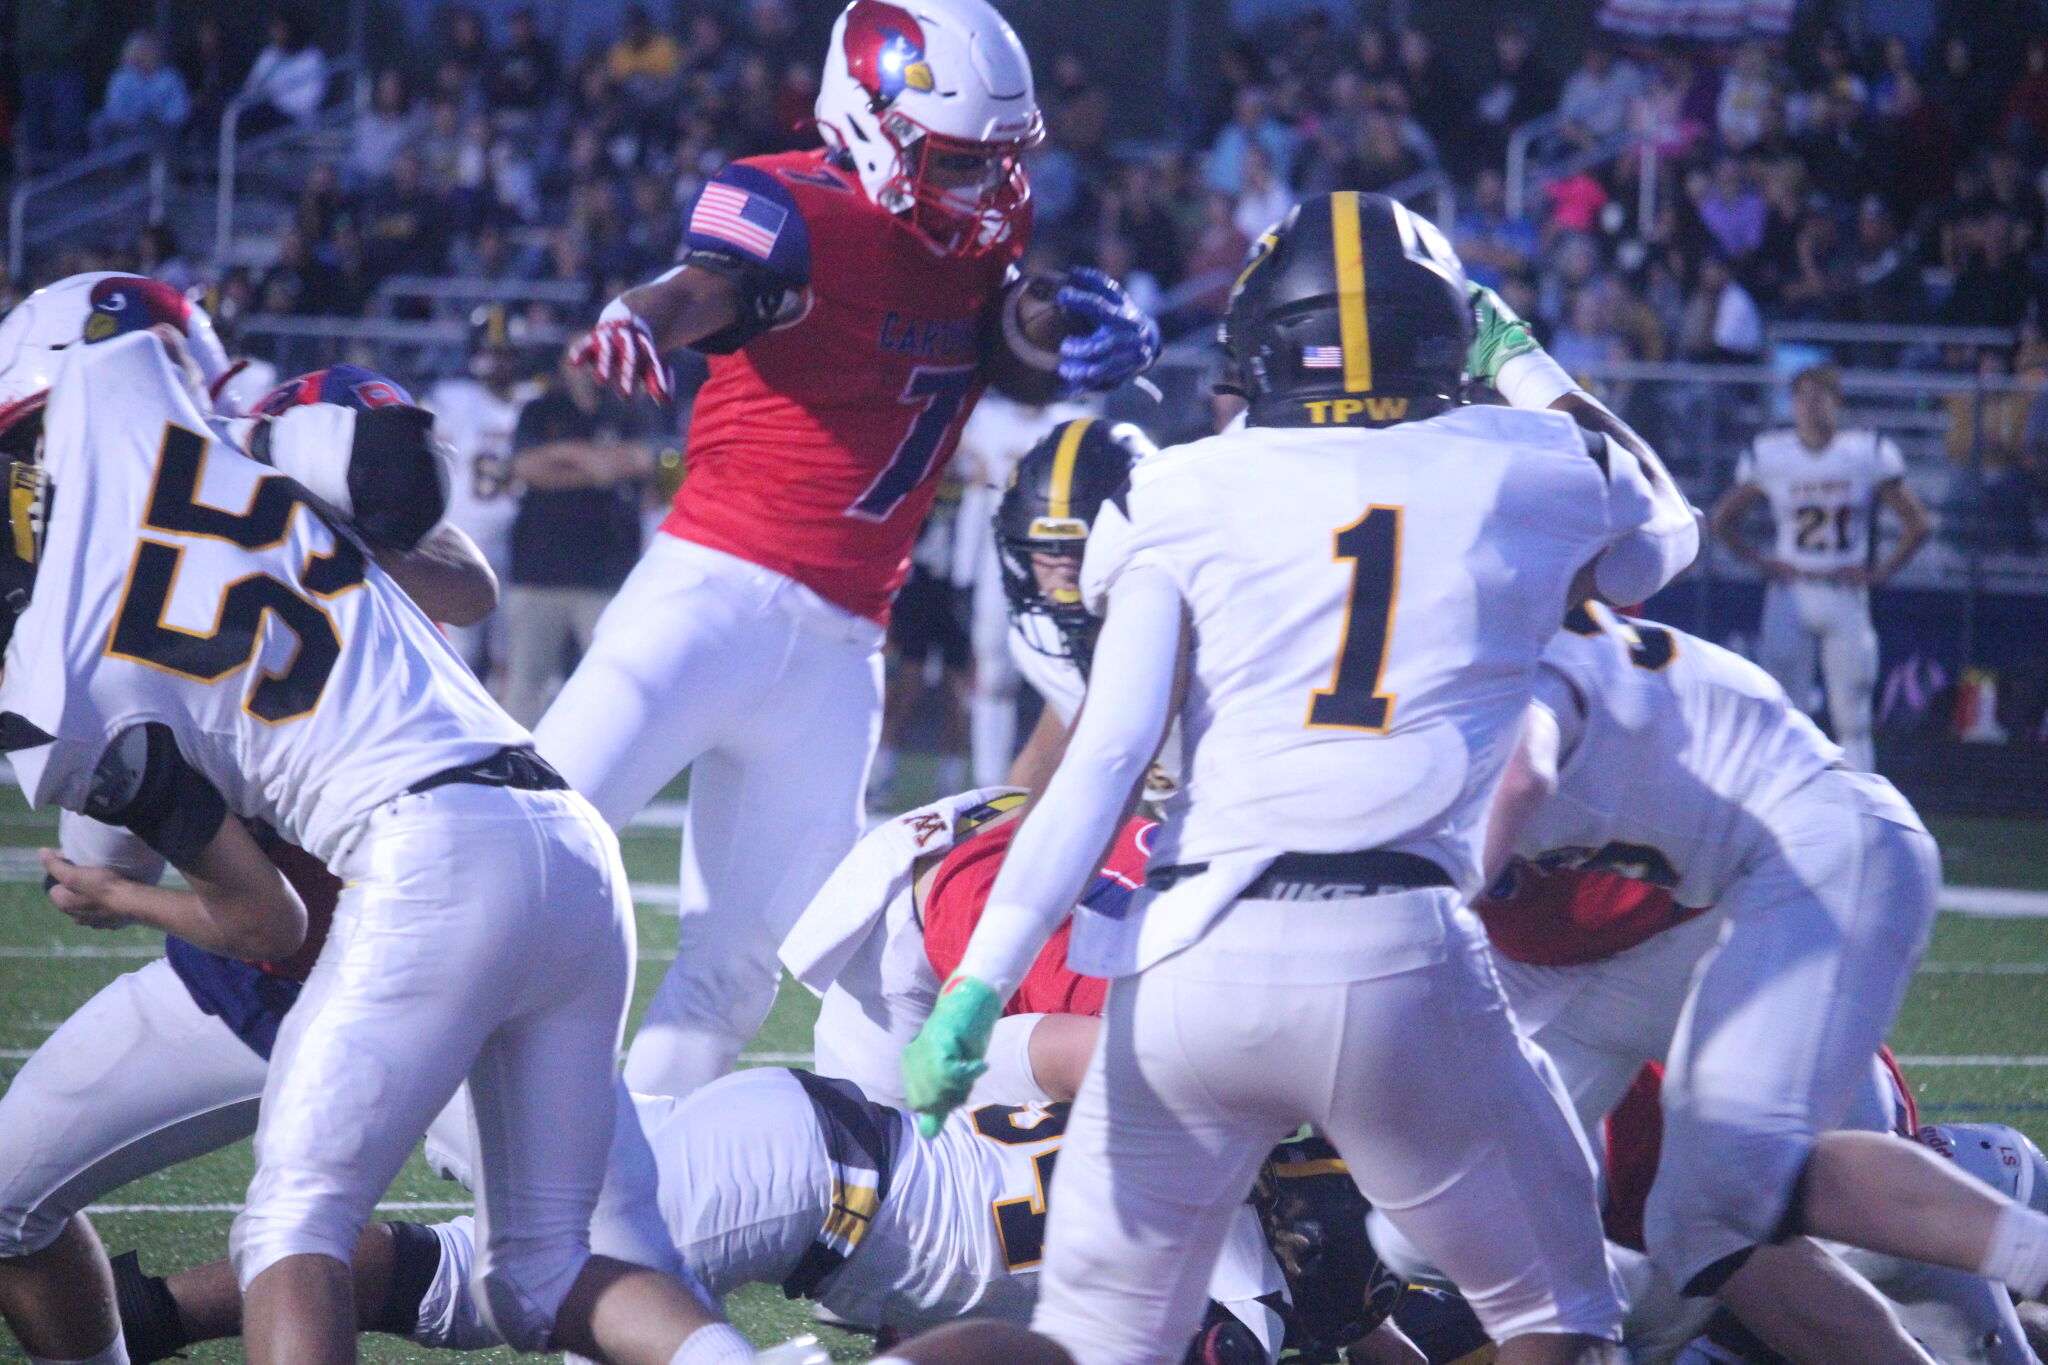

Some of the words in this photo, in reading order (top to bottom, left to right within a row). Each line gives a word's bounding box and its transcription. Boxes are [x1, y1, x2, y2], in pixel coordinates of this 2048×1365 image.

[843, 363, 977, 524] 7
[1304, 398, 1408, 424] TPW
[1797, 505, 1850, 551] 21
[1303, 503, 1405, 735] 1
